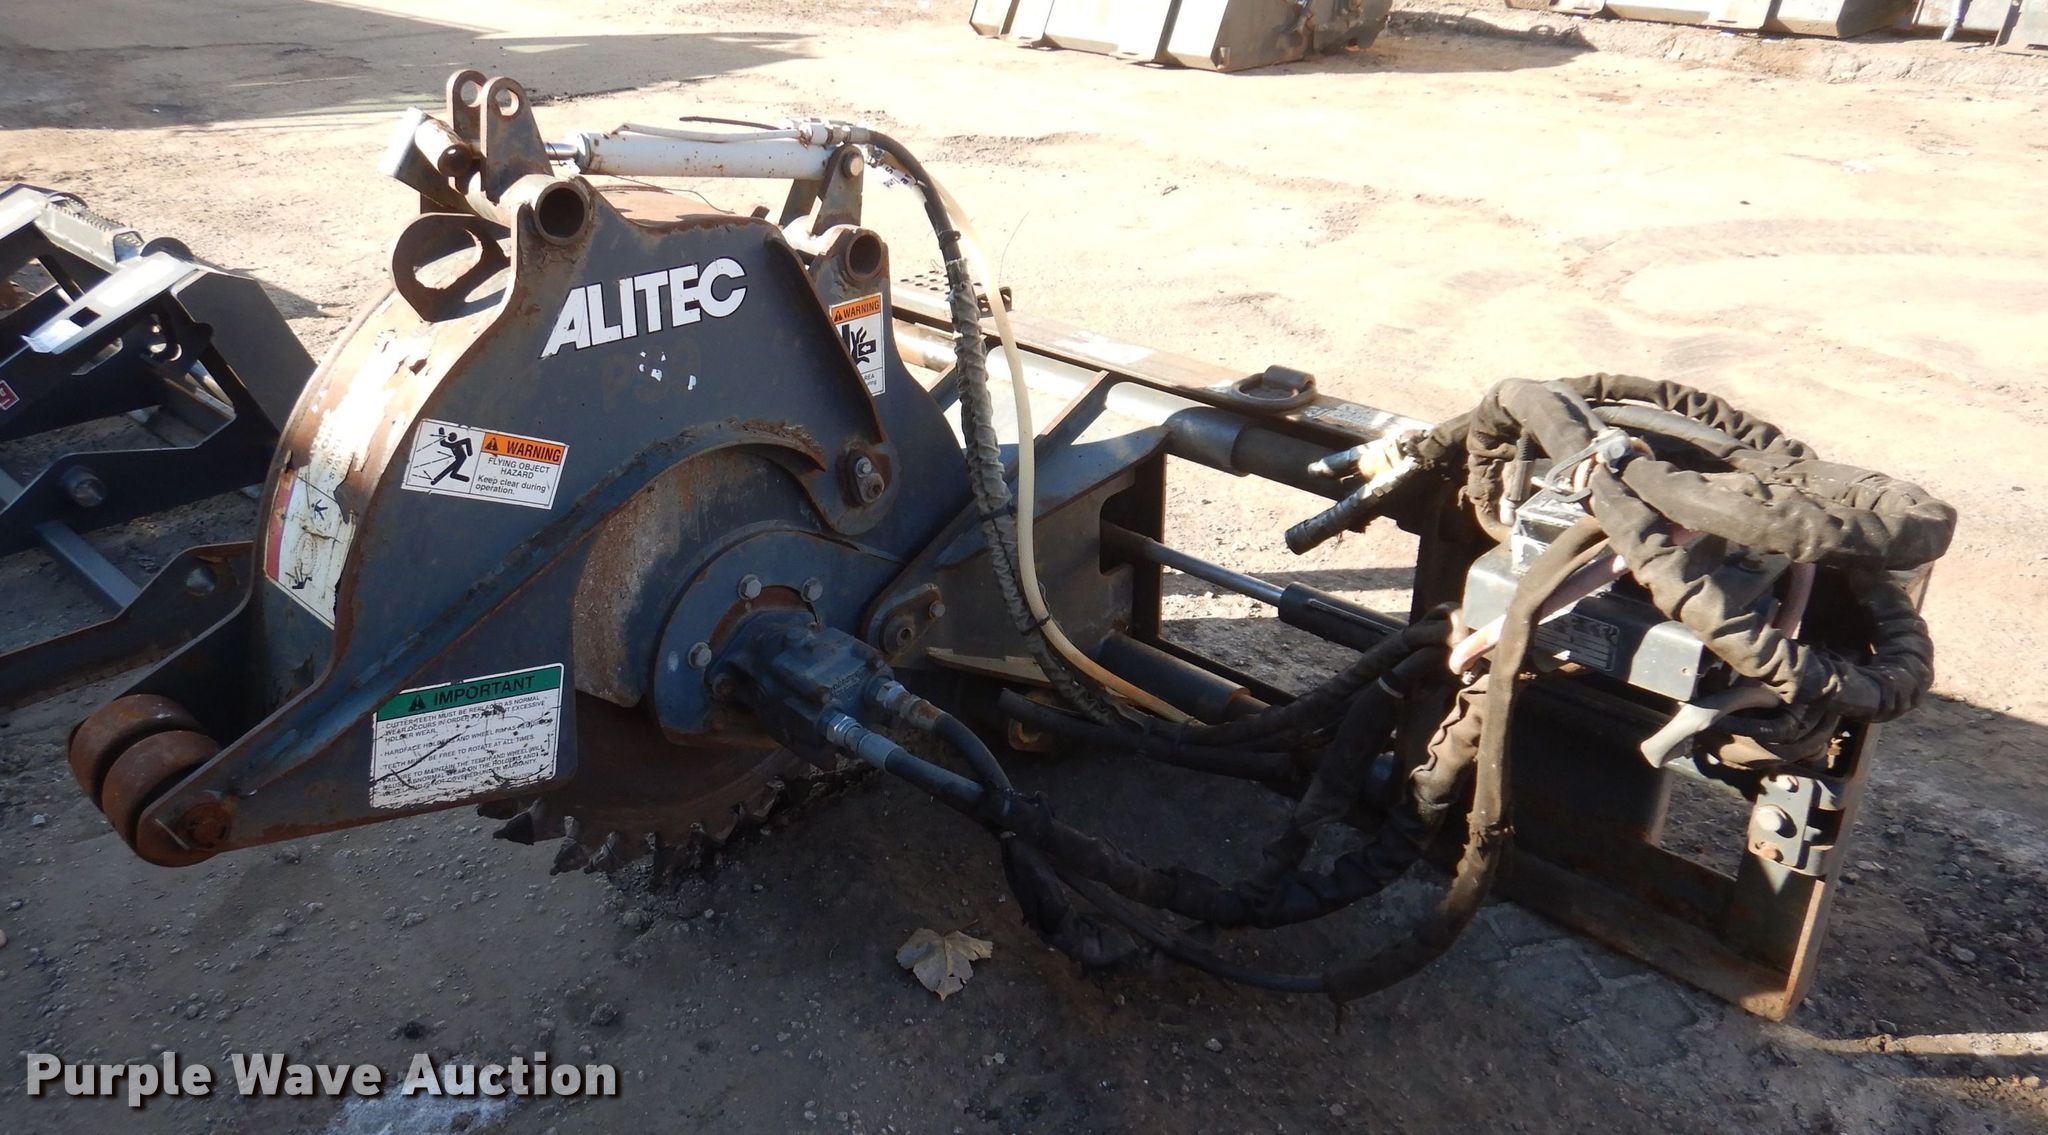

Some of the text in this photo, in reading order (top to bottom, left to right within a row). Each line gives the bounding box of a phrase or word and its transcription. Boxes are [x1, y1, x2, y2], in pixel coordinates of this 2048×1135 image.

[541, 257, 747, 360] ALITEC
[843, 301, 880, 318] WARNING
[506, 440, 561, 462] WARNING
[487, 457, 550, 473] FLYING OBJECT
[500, 468, 534, 479] HAZARD
[475, 484, 515, 495] operation.
[477, 475, 547, 494] Keep clear during
[433, 676, 535, 706] IMPORTANT
[437, 710, 456, 719] MUST
[514, 694, 539, 704] NORMAL
[382, 759, 405, 769] TEETH
[438, 750, 454, 758] FREE
